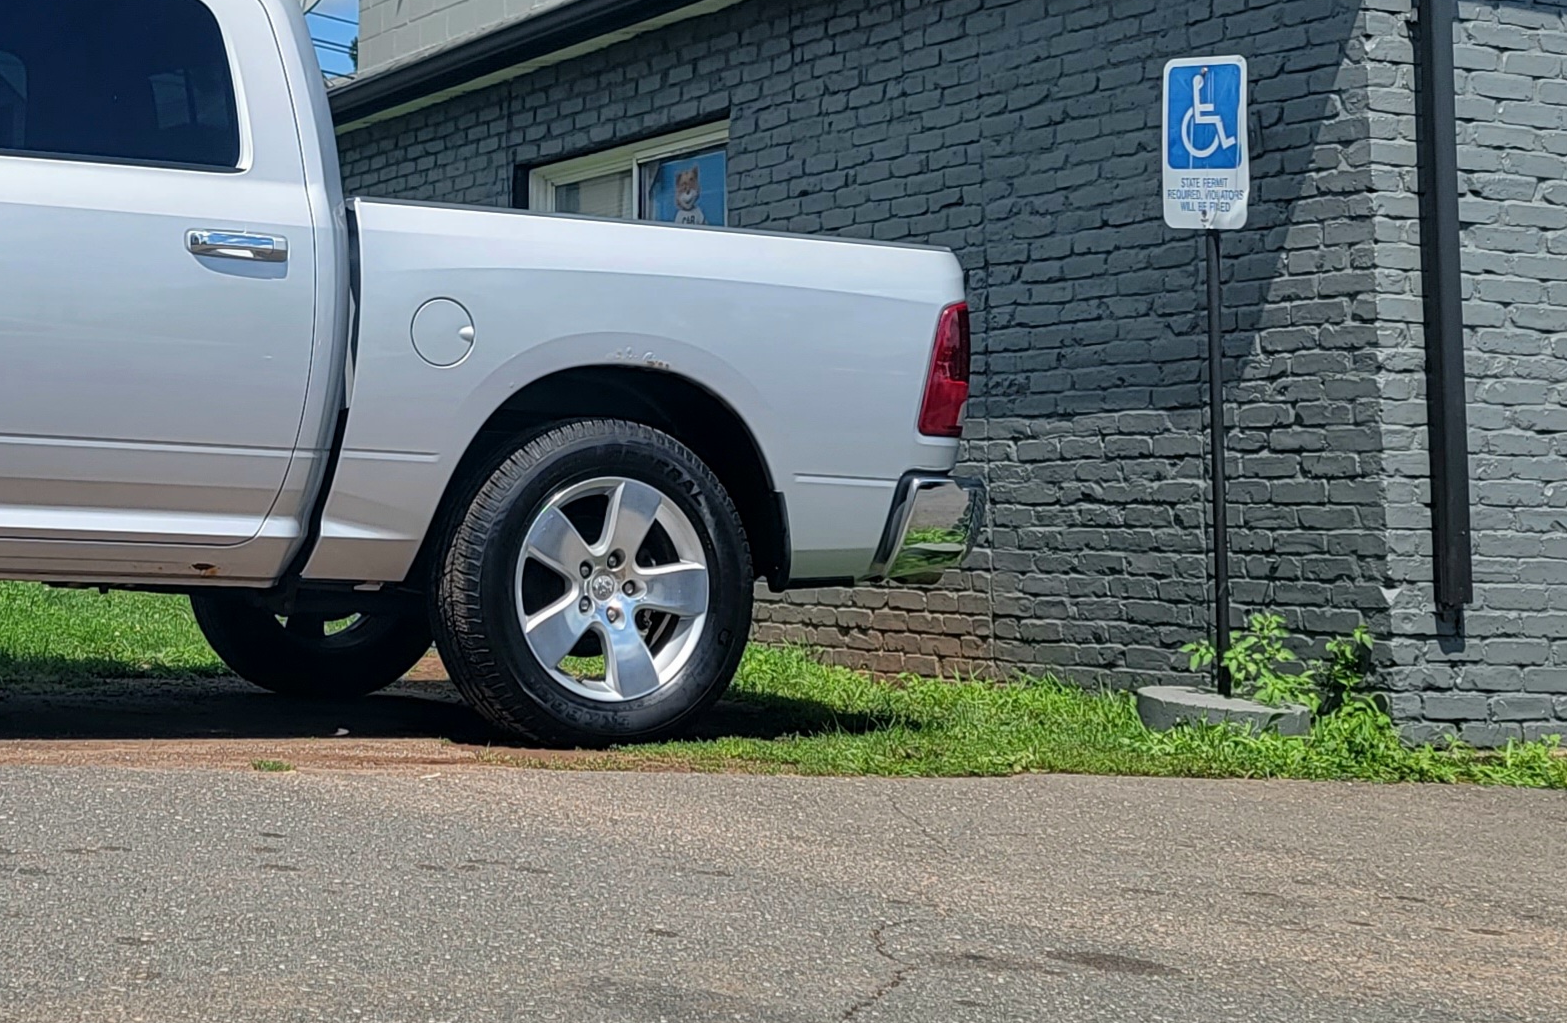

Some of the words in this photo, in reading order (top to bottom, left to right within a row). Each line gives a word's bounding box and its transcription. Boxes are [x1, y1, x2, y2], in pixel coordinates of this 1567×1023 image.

[1180, 177, 1201, 188] STATE
[1202, 177, 1228, 188] PERMIT
[1205, 189, 1245, 201] VIOLATORS
[1180, 201, 1196, 212] WILL
[1197, 201, 1207, 212] BE
